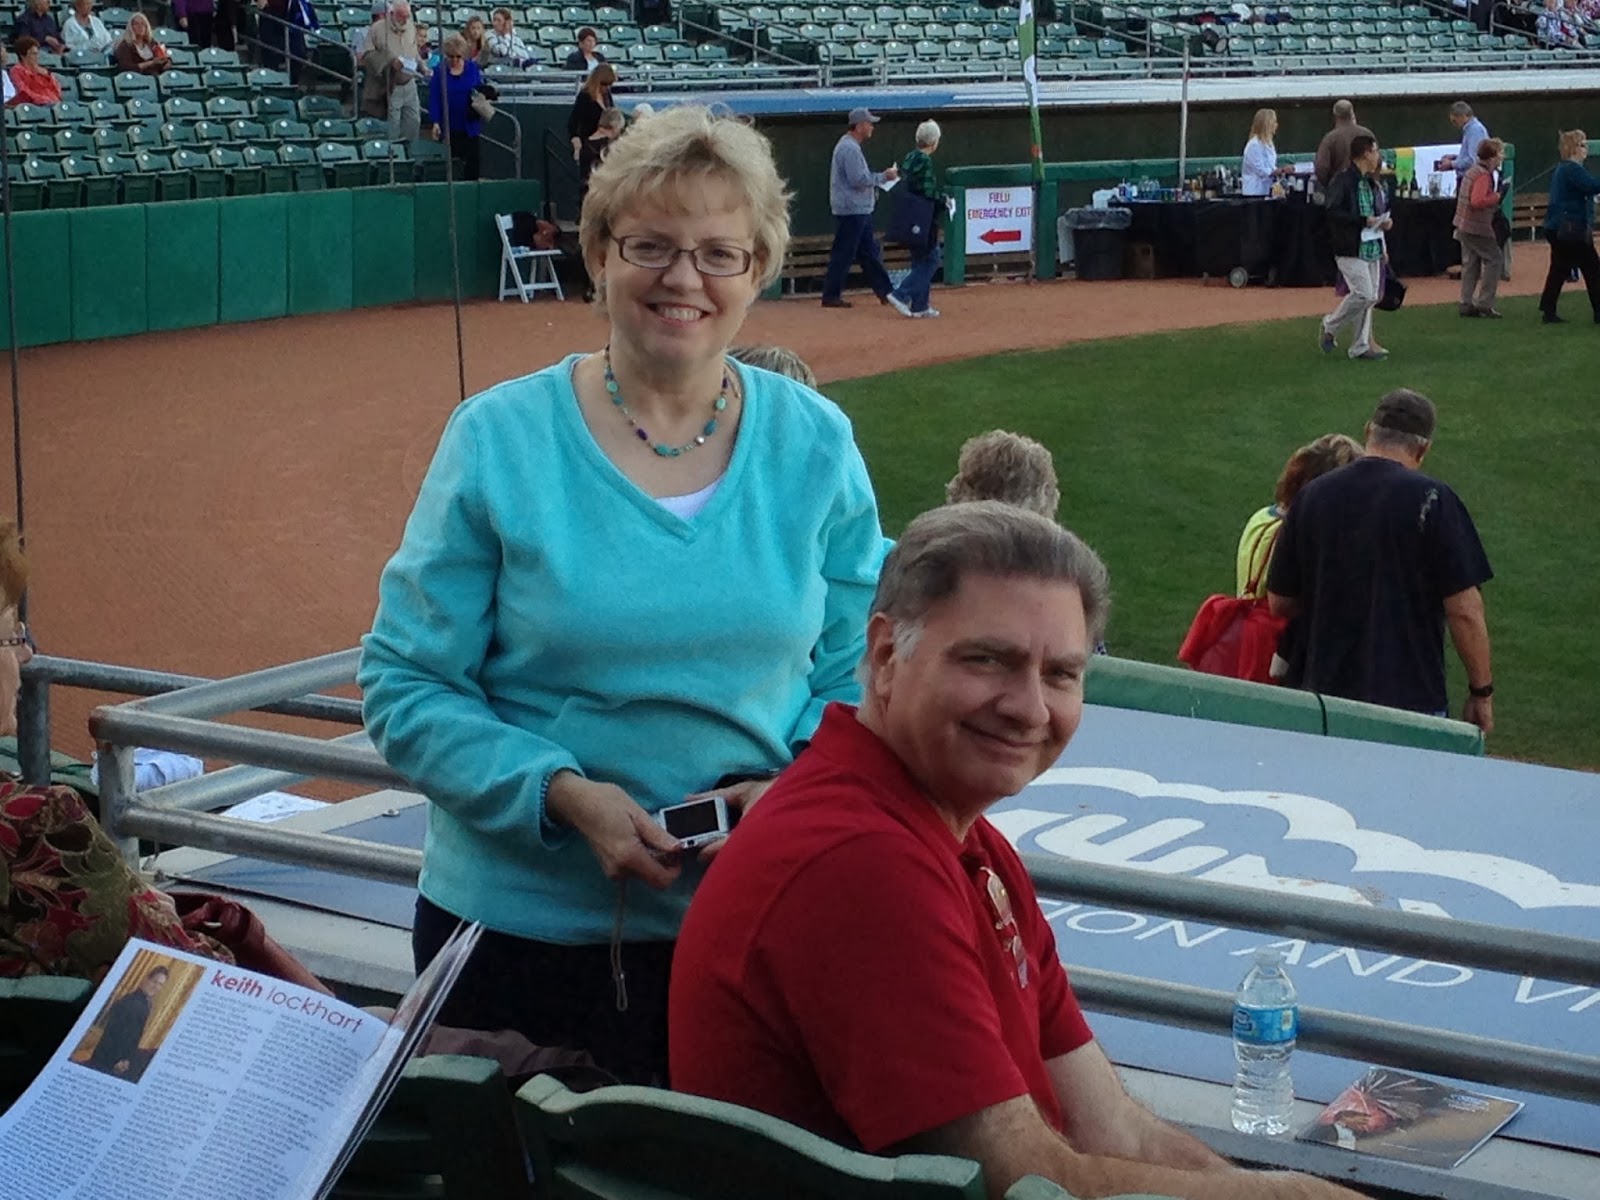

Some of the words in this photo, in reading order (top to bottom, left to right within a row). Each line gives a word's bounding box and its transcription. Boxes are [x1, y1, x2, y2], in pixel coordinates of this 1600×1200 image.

[967, 208, 1013, 219] EMERGENCY
[1015, 207, 1032, 217] EXIT
[1228, 938, 1474, 988] AND
[210, 970, 263, 998] keith
[266, 985, 364, 1034] lockhart
